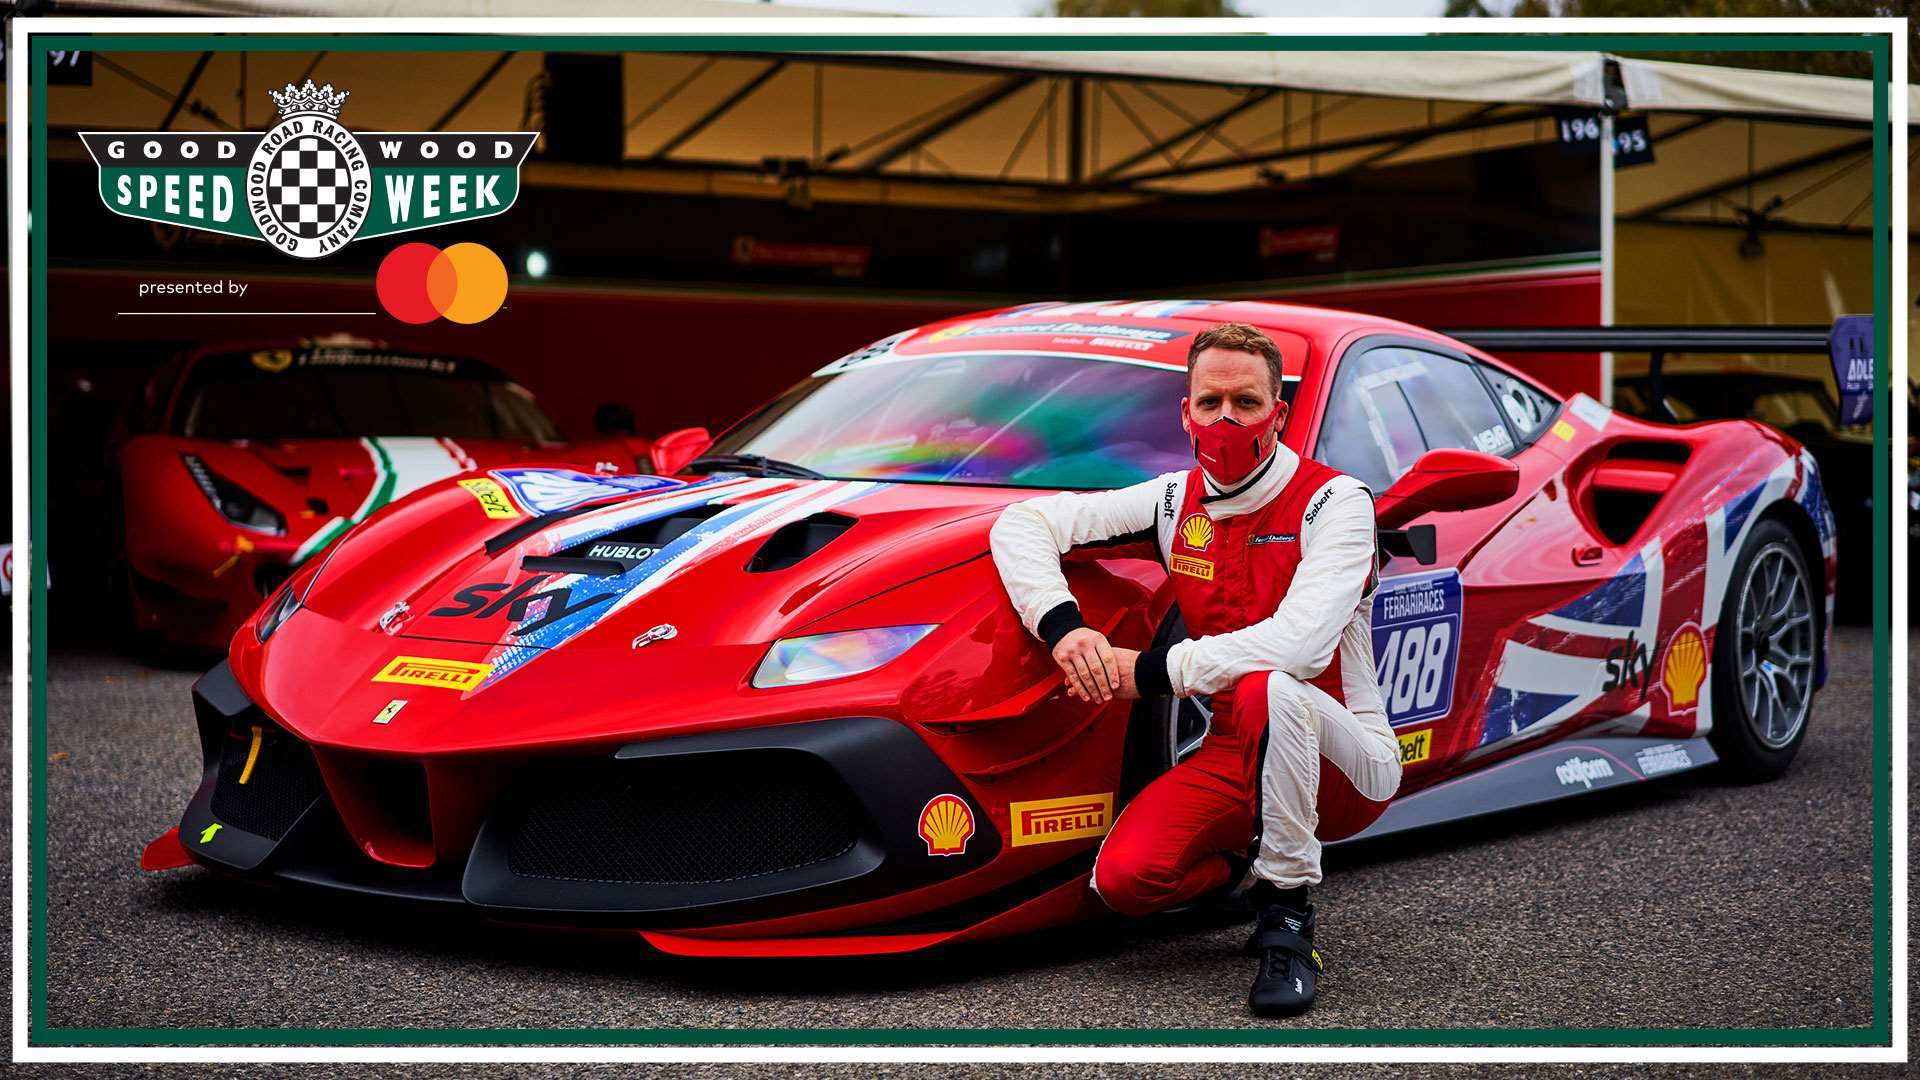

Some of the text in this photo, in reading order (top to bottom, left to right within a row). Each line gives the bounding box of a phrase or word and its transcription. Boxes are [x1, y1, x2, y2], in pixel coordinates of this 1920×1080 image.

[1561, 117, 1600, 141] 196
[1164, 481, 1178, 520] Sabelt
[1304, 487, 1335, 525] Sabelt
[588, 544, 660, 560] HUBLOT
[1172, 556, 1211, 577] PIRELLI
[387, 661, 480, 684] PIRELLI
[1376, 622, 1451, 715] 488
[1602, 629, 1661, 703] sky
[1021, 802, 1105, 837] PIRELLI
